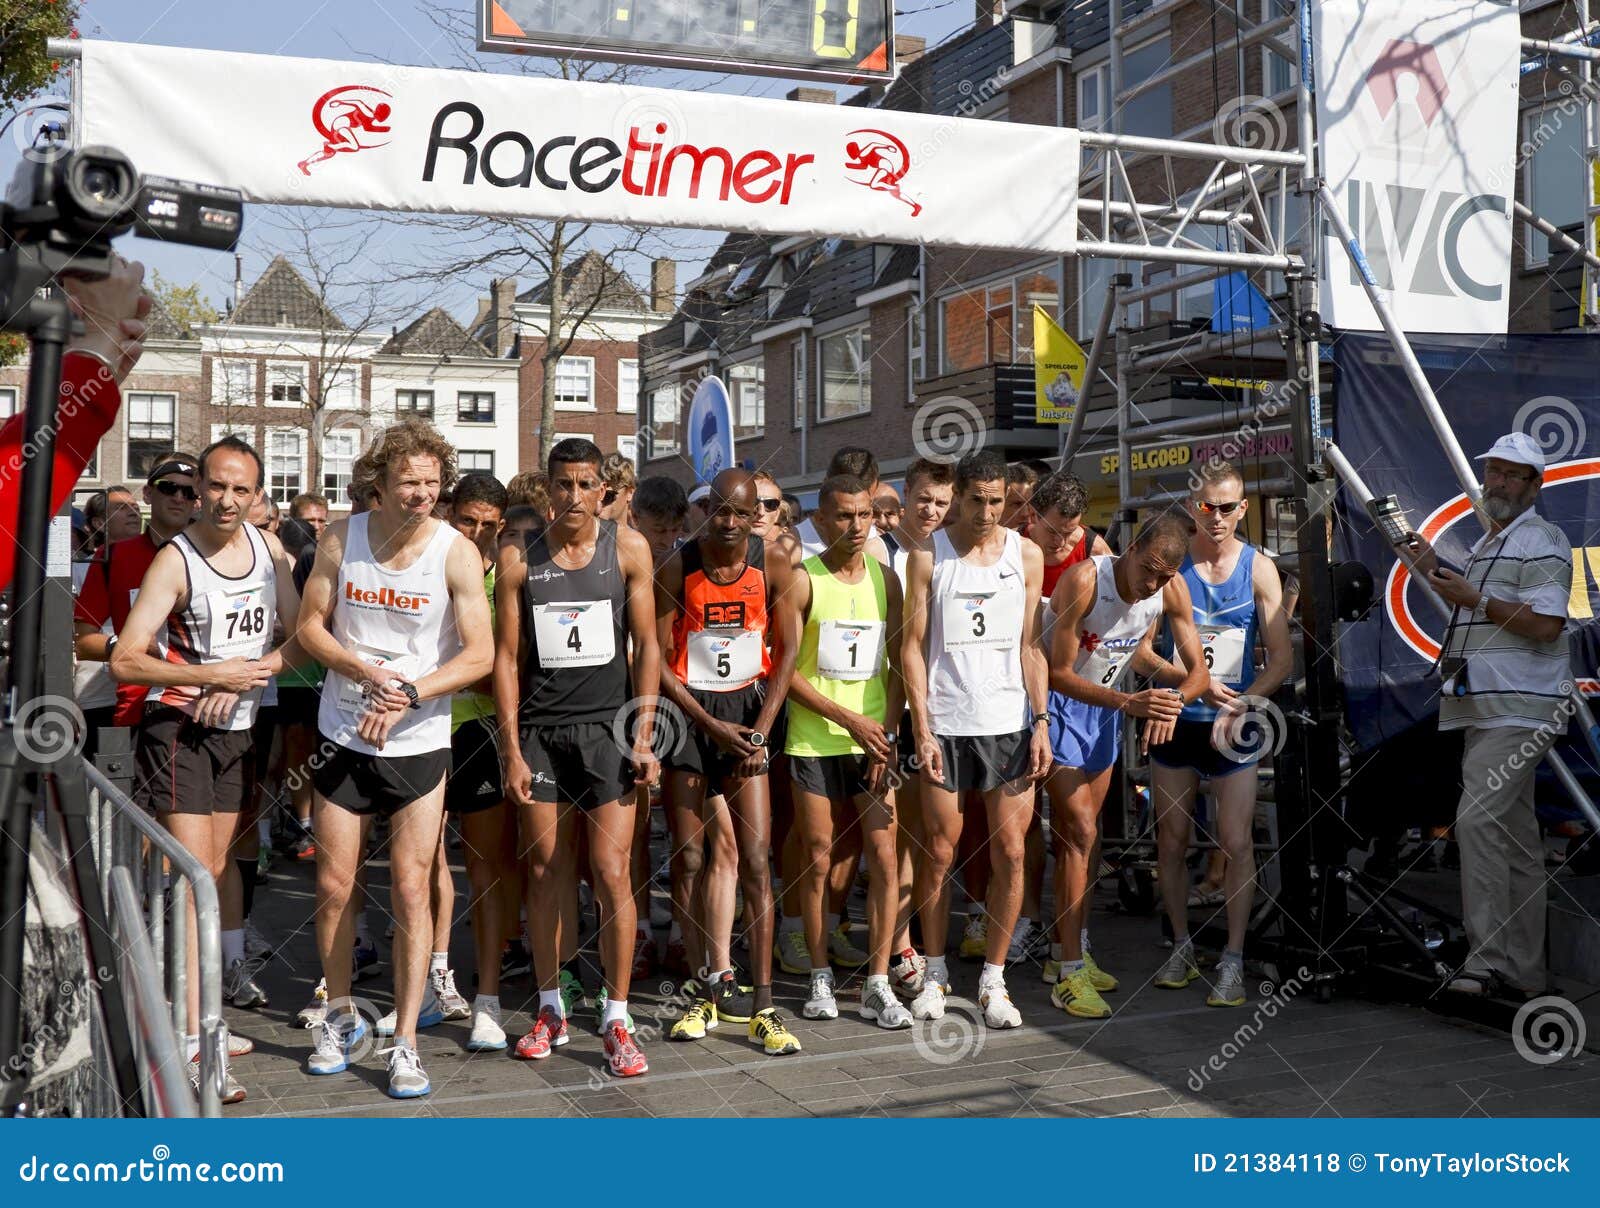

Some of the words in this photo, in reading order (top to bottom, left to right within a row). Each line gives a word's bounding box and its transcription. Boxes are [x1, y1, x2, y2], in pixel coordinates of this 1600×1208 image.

[422, 101, 815, 205] Racetimer
[346, 582, 430, 610] keller
[226, 607, 264, 639] 748
[972, 612, 986, 637] 3
[567, 626, 582, 653] 4
[717, 653, 731, 678] 5
[848, 643, 857, 668] 1
[1203, 646, 1214, 670] 6
[1101, 665, 1118, 685] 8
